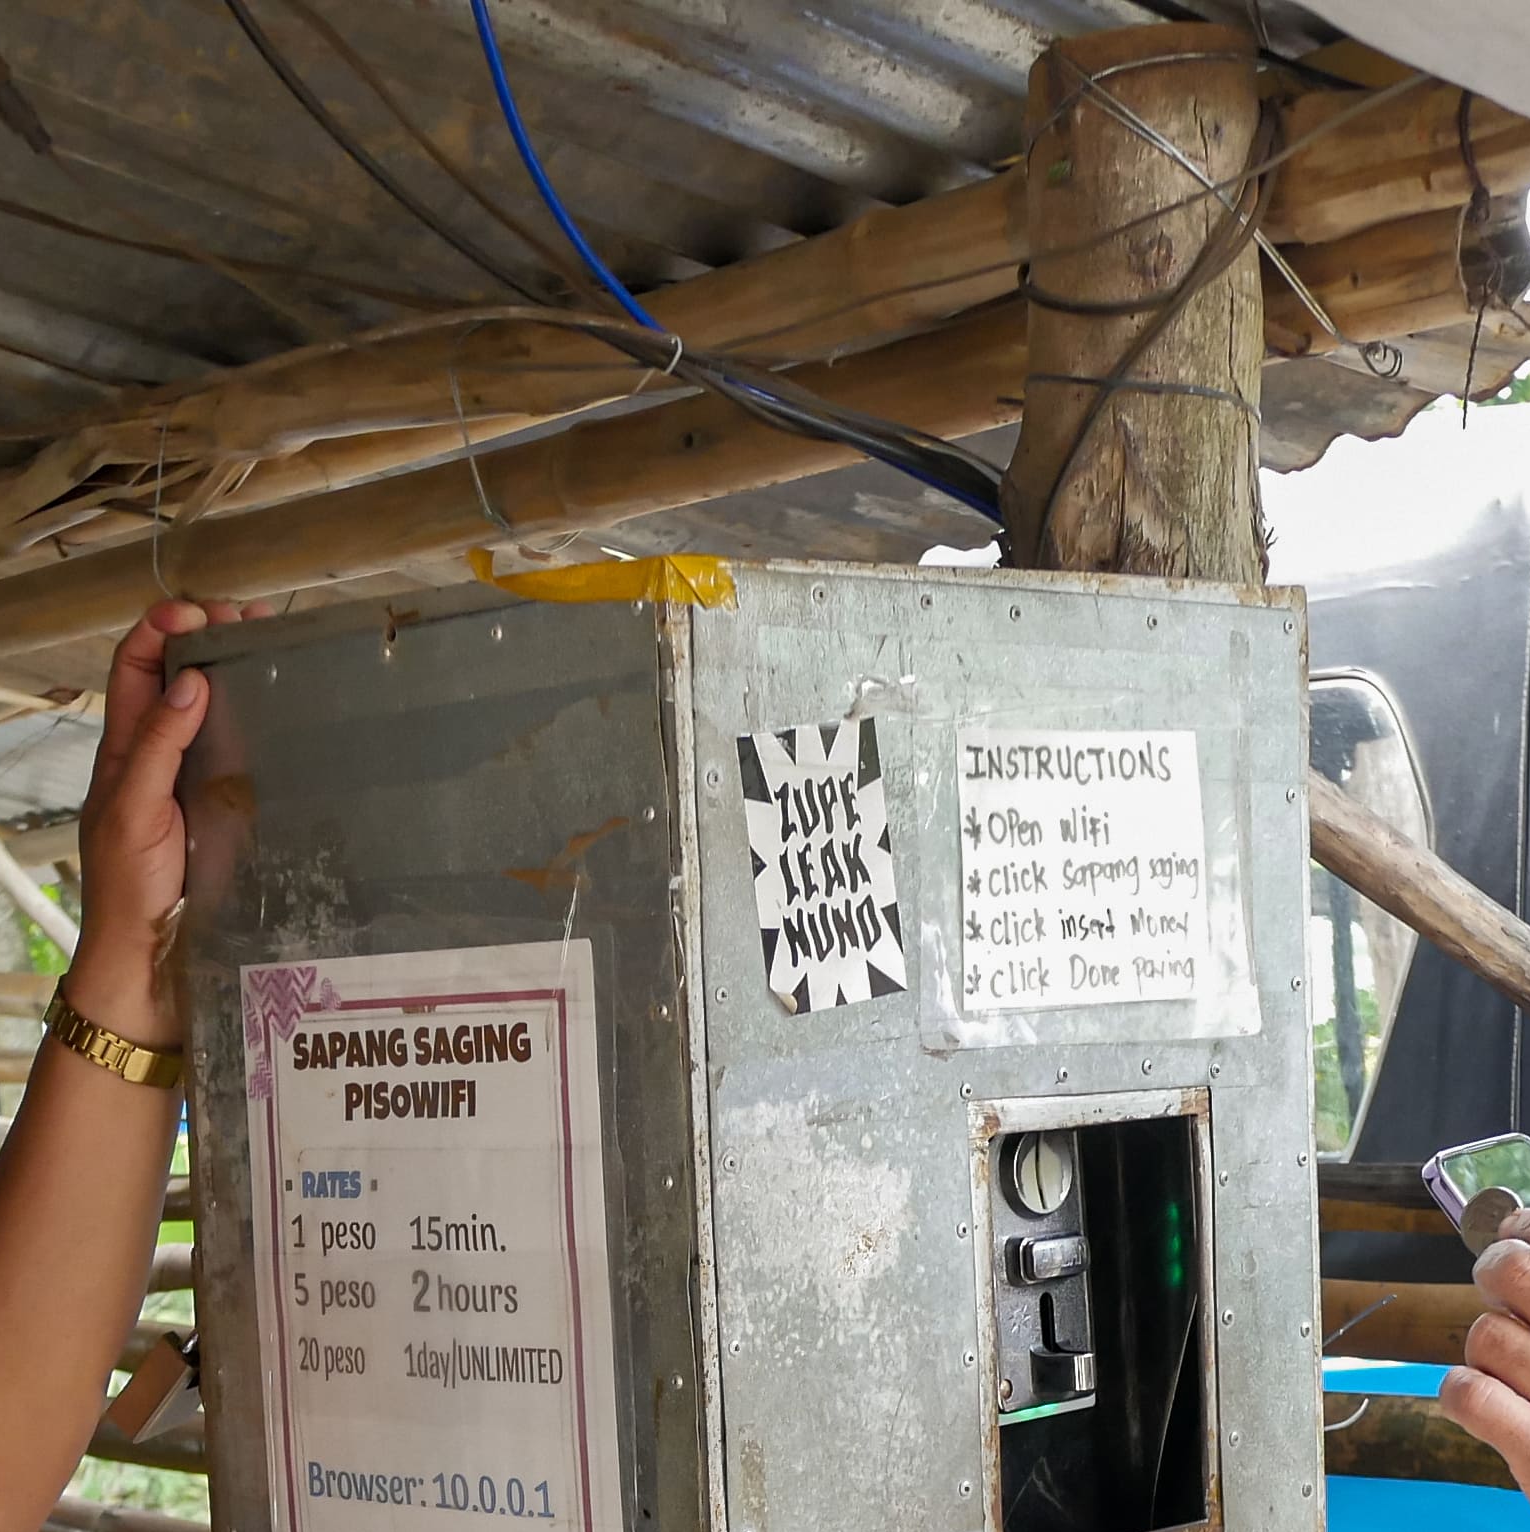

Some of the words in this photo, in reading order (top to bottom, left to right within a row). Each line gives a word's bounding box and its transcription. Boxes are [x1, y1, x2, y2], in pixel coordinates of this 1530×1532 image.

[966, 740, 1171, 784] INSTRUCTIONS
[779, 833, 871, 906] LEAK
[1069, 954, 1120, 990] Done
[292, 1028, 408, 1070] SAPANG
[413, 1021, 532, 1066] SAGING
[344, 1080, 477, 1121] PISOWIFI
[301, 1170, 362, 1199] RATES
[291, 1214, 306, 1248] 1
[321, 1220, 376, 1256] peso
[409, 1213, 507, 1252] 15min.
[294, 1273, 310, 1306] 5
[320, 1280, 376, 1315] peso
[412, 1269, 431, 1312] 2
[437, 1275, 518, 1314] hours
[299, 1337, 319, 1372] 20
[324, 1343, 366, 1381] peso
[307, 1461, 427, 1508] Browser:
[432, 1472, 556, 1519] 10.0.0.1
